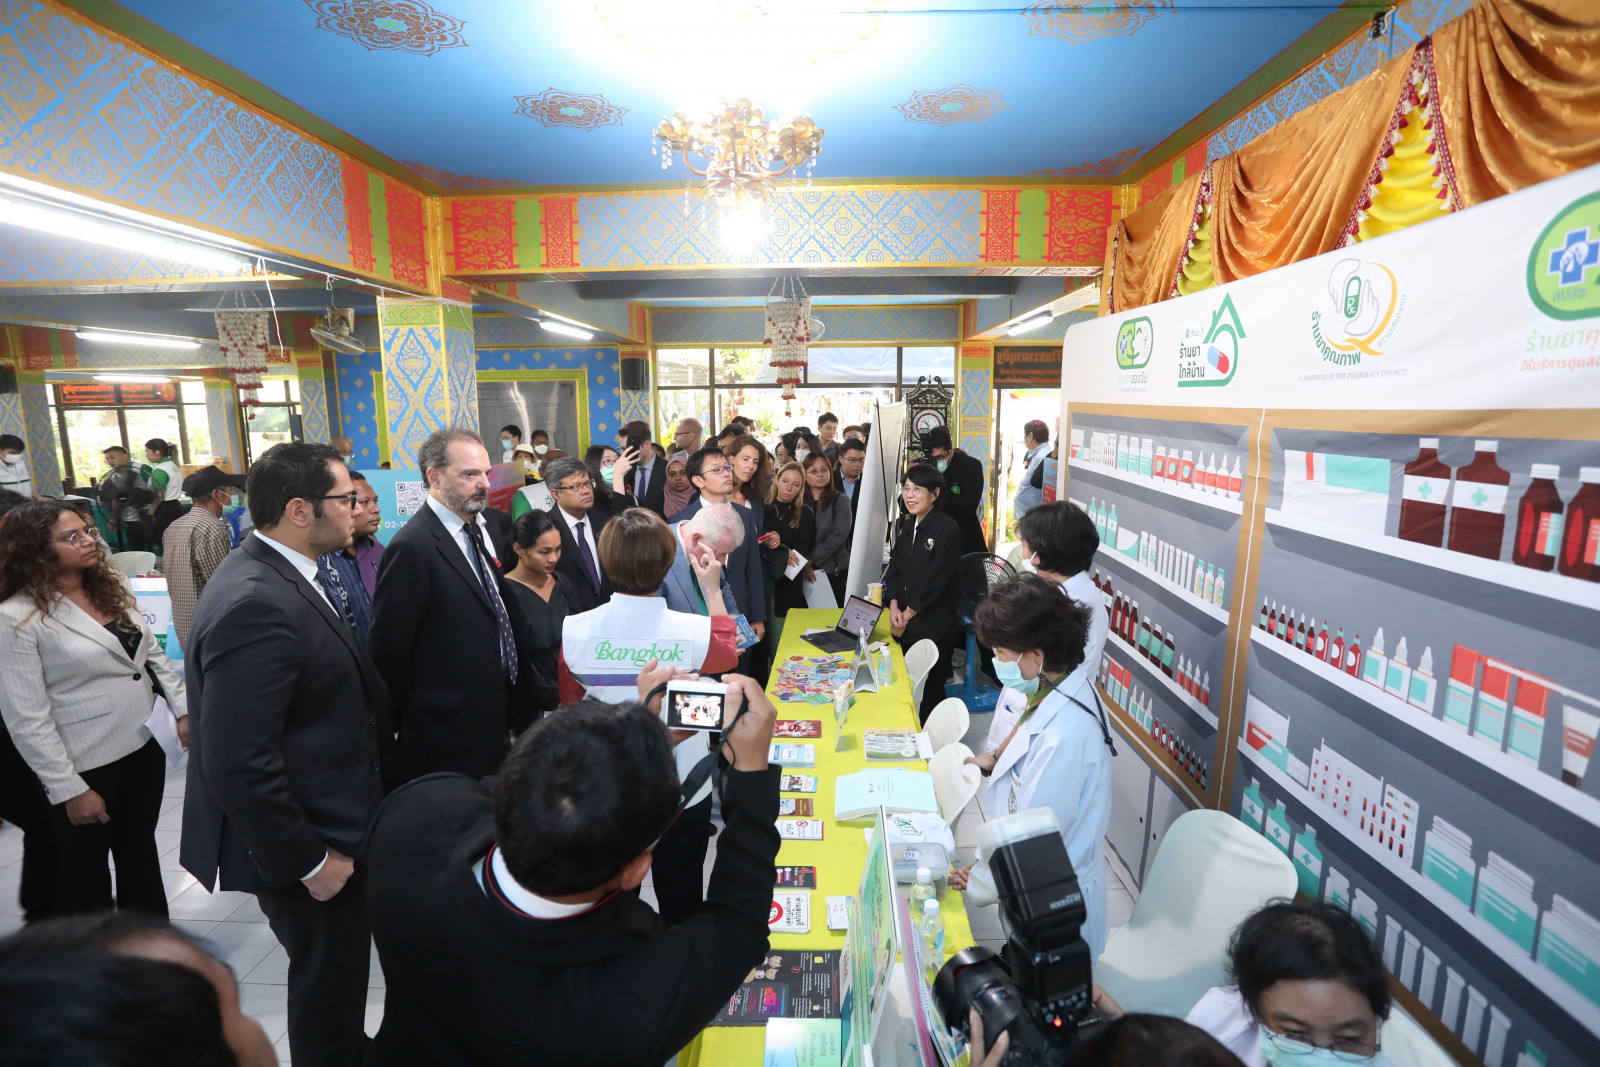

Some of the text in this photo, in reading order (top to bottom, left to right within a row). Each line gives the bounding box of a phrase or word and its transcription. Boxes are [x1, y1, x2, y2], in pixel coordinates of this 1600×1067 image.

[1311, 310, 1361, 366] ร้านยาคุณภาพ
[1179, 342, 1201, 358] ร้านยา
[1179, 361, 1205, 378] ใกล้บ้าน
[1347, 371, 1380, 380] PHARMACY
[1380, 368, 1408, 378] COUNCIL
[595, 640, 685, 667] Bangkok
